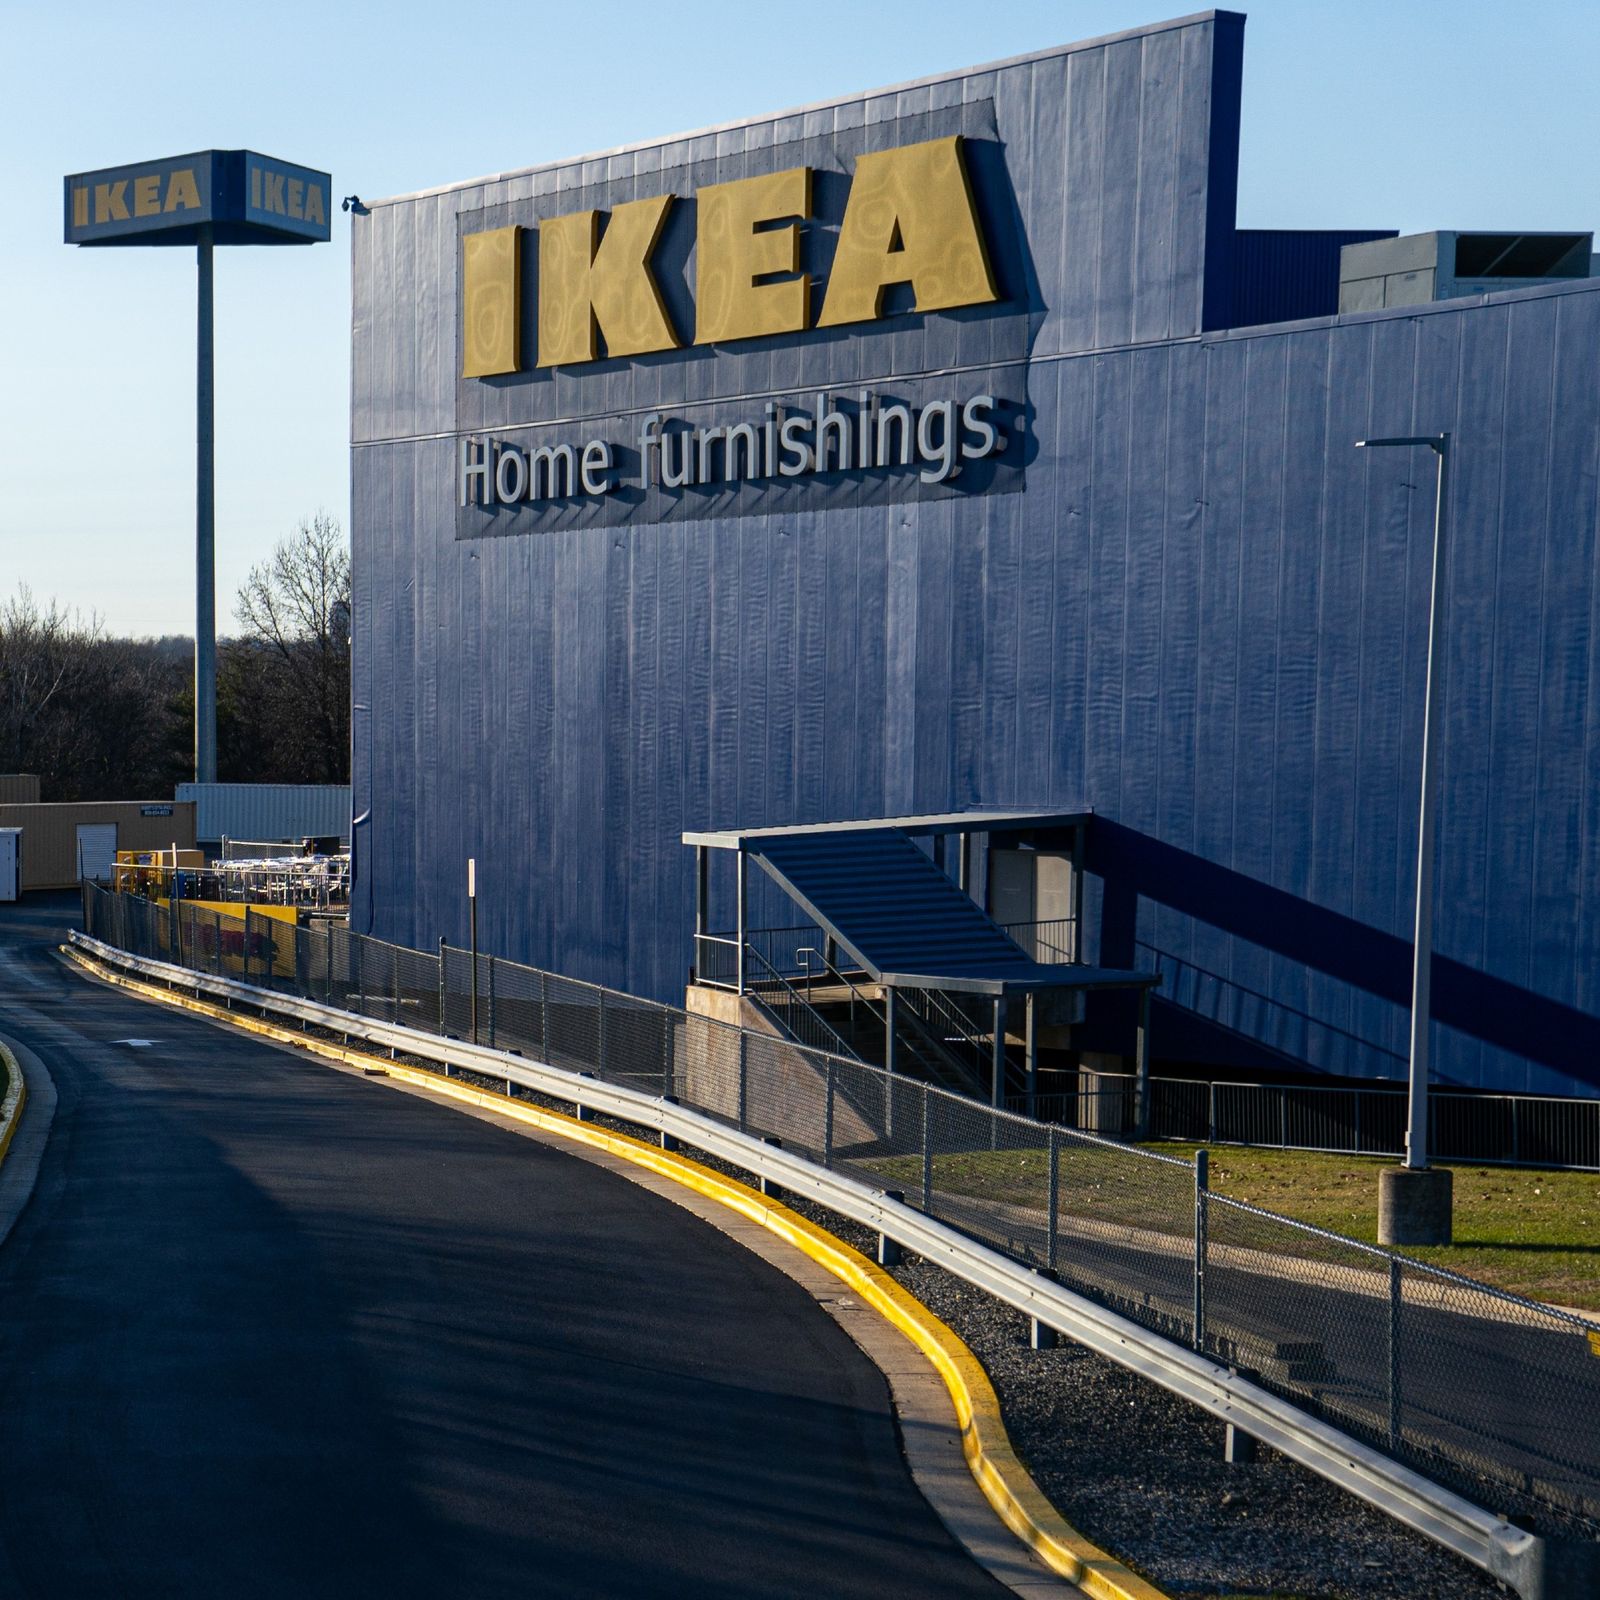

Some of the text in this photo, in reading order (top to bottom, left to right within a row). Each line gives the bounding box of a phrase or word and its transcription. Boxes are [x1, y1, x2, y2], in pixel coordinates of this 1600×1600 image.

[74, 169, 201, 227] IKEA
[252, 168, 325, 225] IKEA
[462, 135, 998, 379] IKEA
[460, 390, 999, 507] Home furnishings
